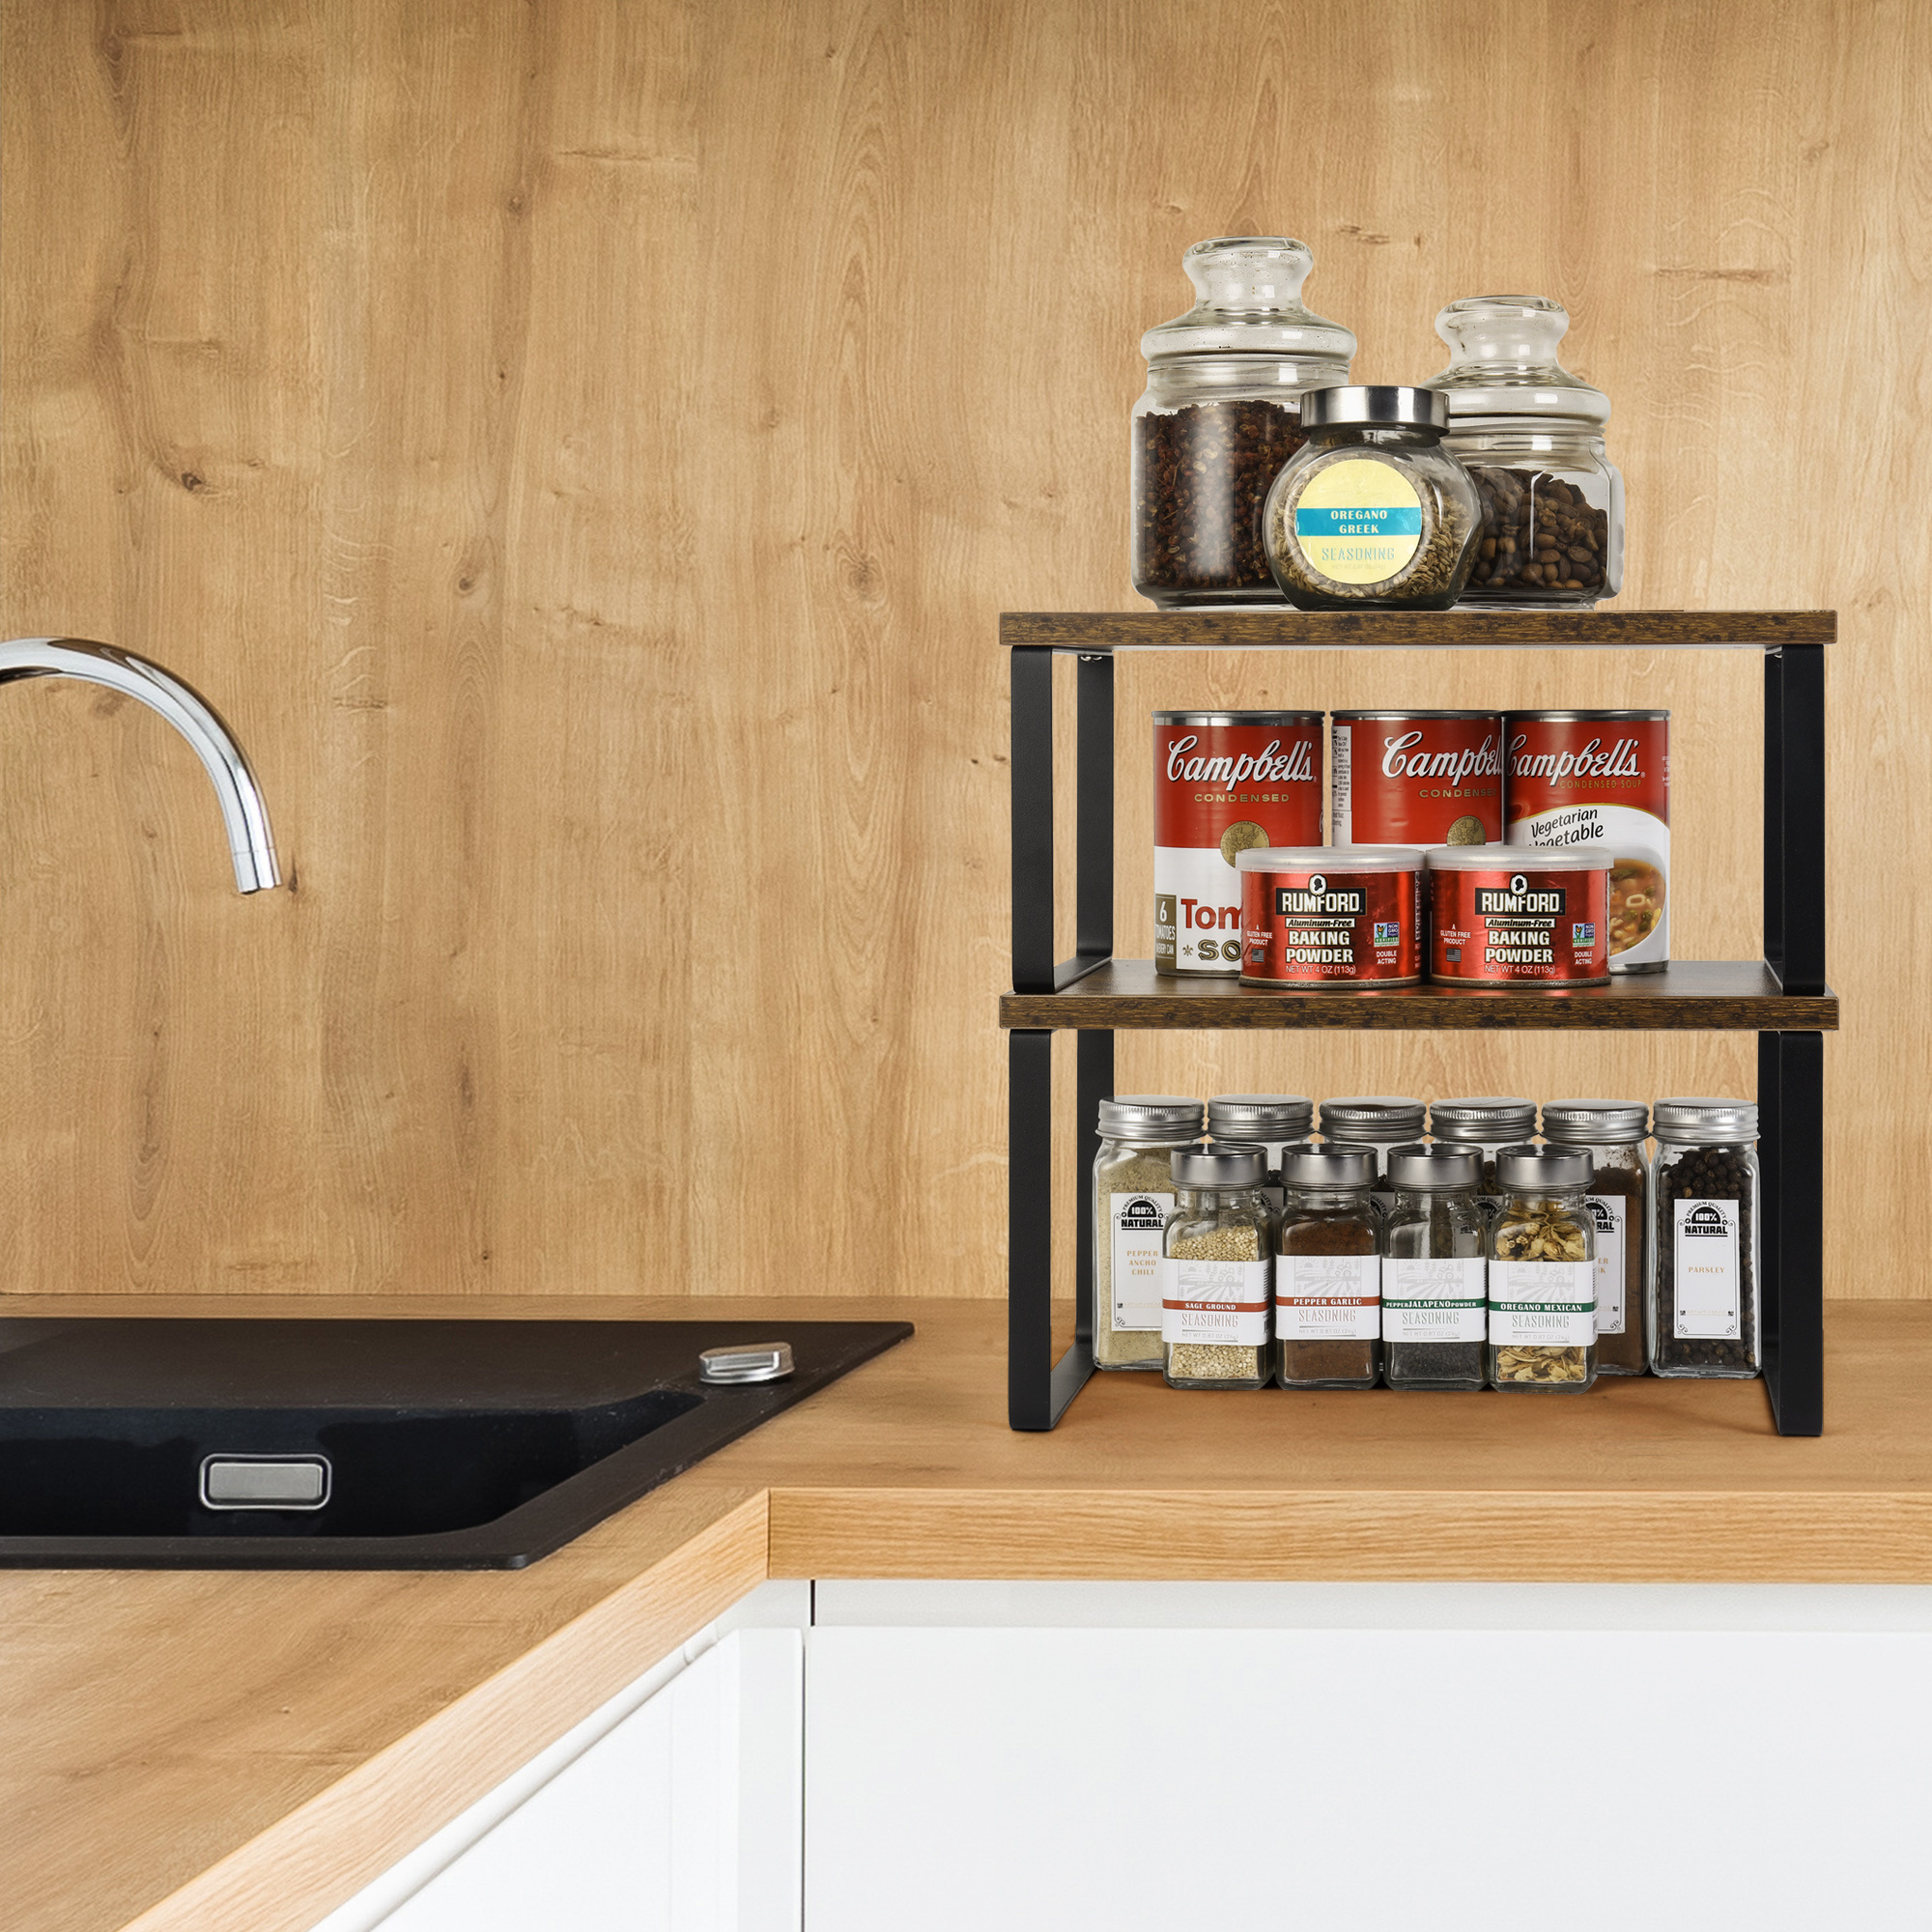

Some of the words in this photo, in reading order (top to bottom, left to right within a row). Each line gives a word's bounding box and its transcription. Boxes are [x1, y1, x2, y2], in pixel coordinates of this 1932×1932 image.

[1330, 510, 1388, 520] OREGANO
[1339, 525, 1379, 534] GREEK
[1321, 548, 1395, 561] SEASONING
[1167, 735, 1313, 791] Campbell's
[1508, 734, 1640, 787] Campbell's
[1560, 780, 1617, 789] CONDENSED
[1621, 780, 1642, 788] SOUP
[1194, 794, 1290, 802] CONDENSED
[1419, 789, 1496, 798] CONDENSED
[1531, 809, 1597, 838] Vegetarian
[1529, 822, 1604, 846] etable
[1282, 893, 1359, 912] RUMFORD
[1482, 893, 1560, 912] RUMFORD
[1160, 901, 1167, 922] 6
[1289, 931, 1350, 945] BAKING
[1489, 931, 1550, 945] BAKING
[1286, 948, 1353, 963] POWDER
[1485, 948, 1554, 963] POWDER
[1334, 966, 1356, 975] (113g)
[1534, 966, 1556, 975] (113g)
[1122, 1195, 1143, 1210] PREMIUM
[1144, 1195, 1163, 1212] QUALITY
[1595, 1198, 1613, 1214] QUALITY
[1687, 1201, 1707, 1216] PREMIUM
[1708, 1202, 1727, 1218] QUALITY
[1132, 1207, 1153, 1215] 100%
[1121, 1219, 1164, 1227] NATURAL
[1182, 1313, 1238, 1327] SEASONING
[1299, 1309, 1356, 1322] SEASONING
[1402, 1312, 1459, 1324] SEASONING
[1512, 1315, 1569, 1328] SEASONING
